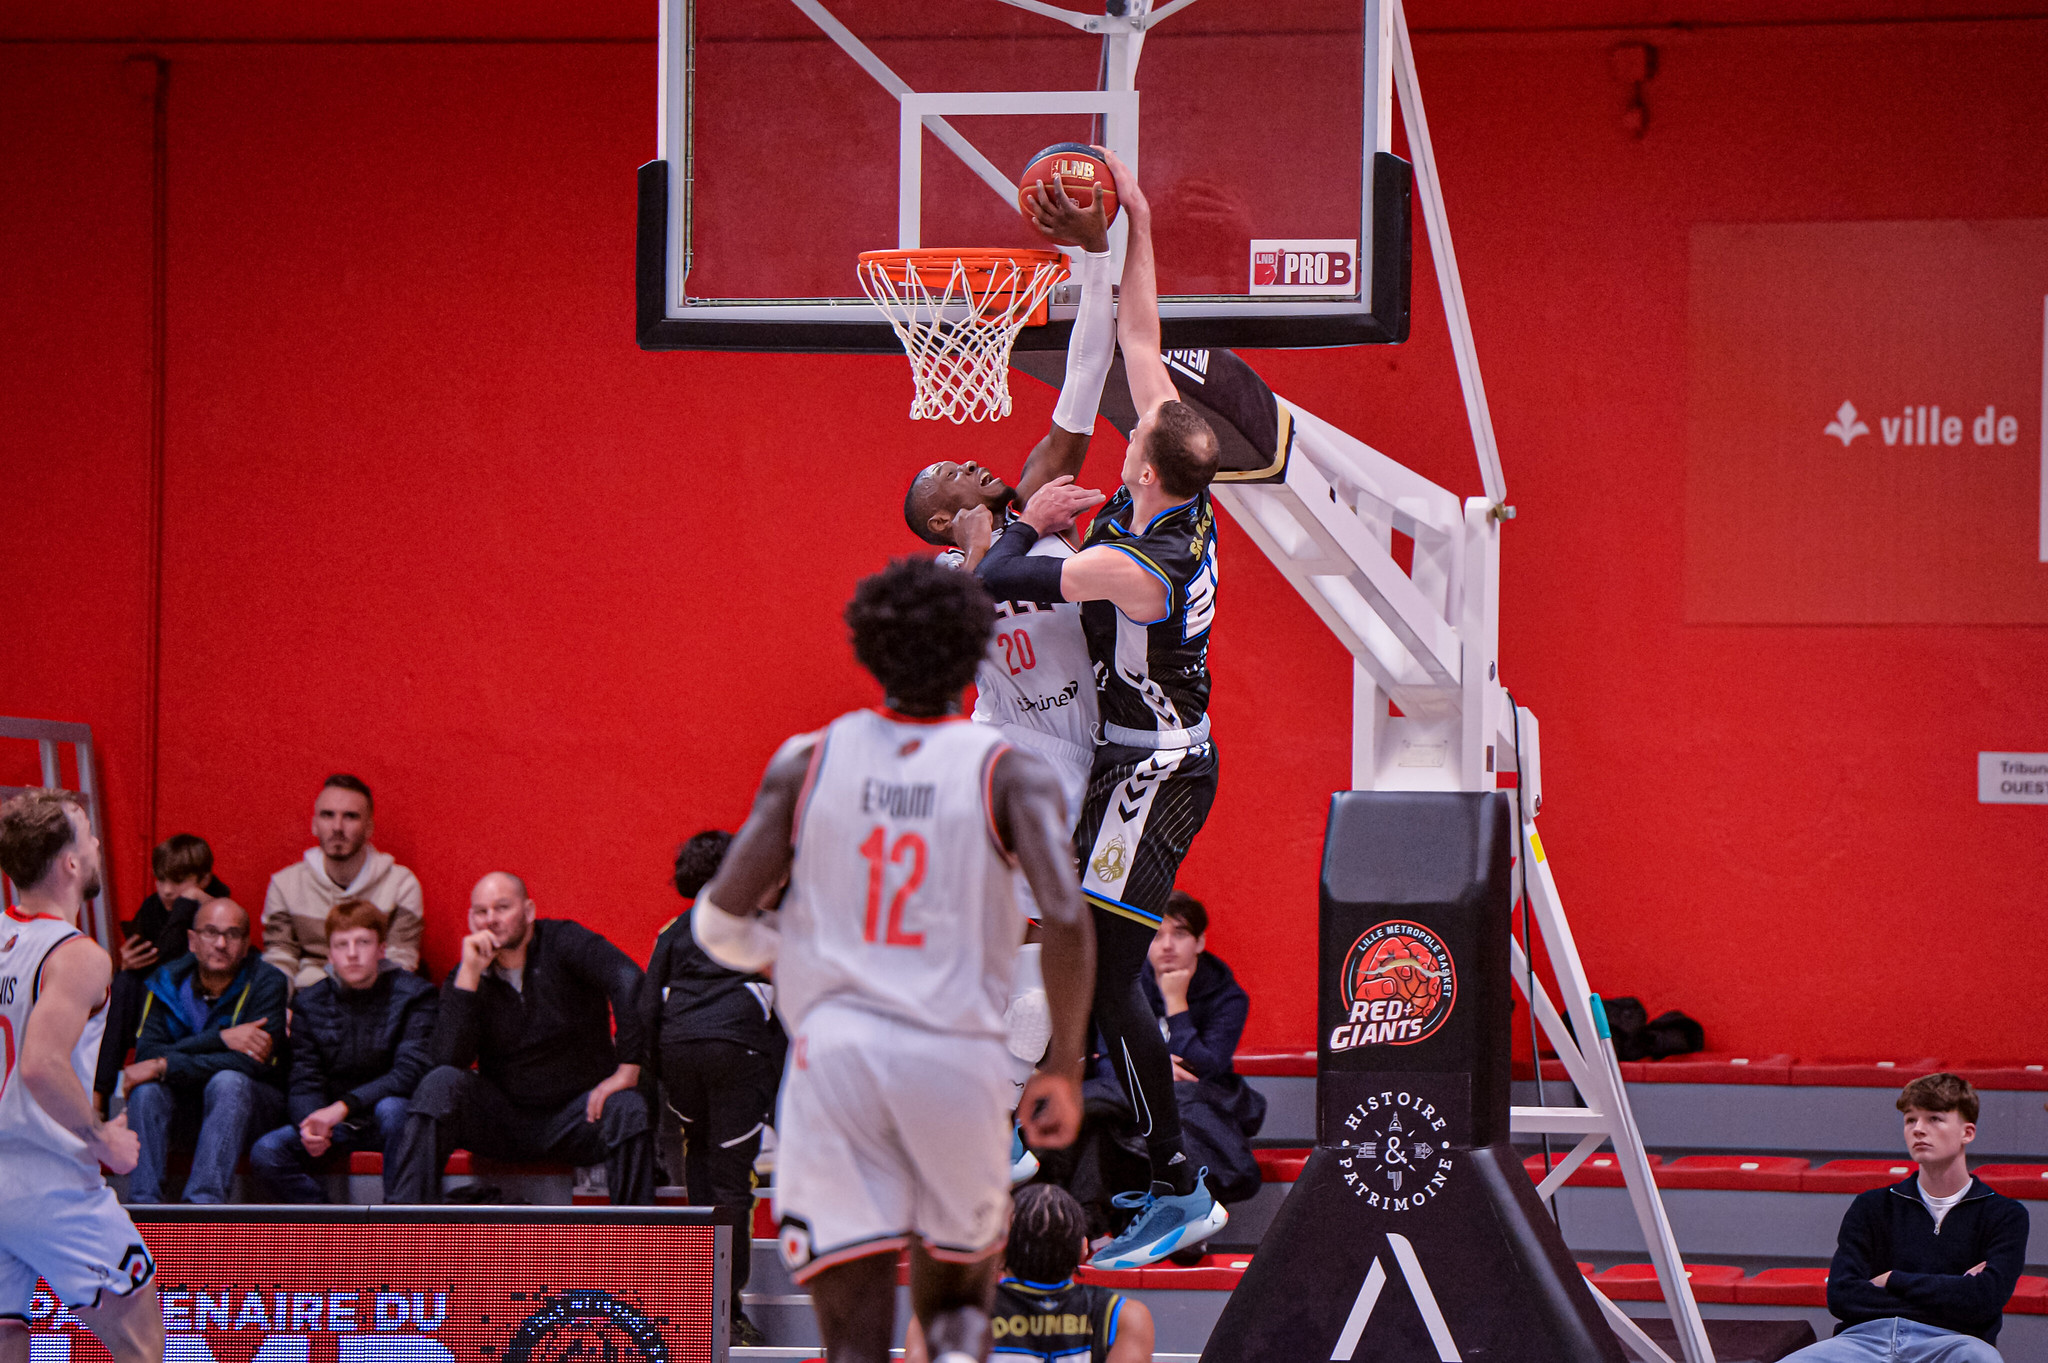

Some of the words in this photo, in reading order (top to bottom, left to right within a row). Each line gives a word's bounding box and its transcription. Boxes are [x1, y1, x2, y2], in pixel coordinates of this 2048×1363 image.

[1060, 160, 1095, 178] LNB
[1256, 253, 1275, 265] LNB
[1880, 405, 1964, 446] ville
[1973, 405, 2019, 446] de
[997, 628, 1036, 676] 20
[859, 824, 928, 948] 12
[1358, 928, 1385, 953] LILLE
[1386, 924, 1442, 953] MÉTROPOLE
[1349, 1000, 1404, 1024] RED
[1330, 1017, 1424, 1050] GIANTS
[1345, 1091, 1447, 1132] HISTOIRE
[1339, 1157, 1453, 1212] PATRIMOINE
[375, 1292, 447, 1331] DU
